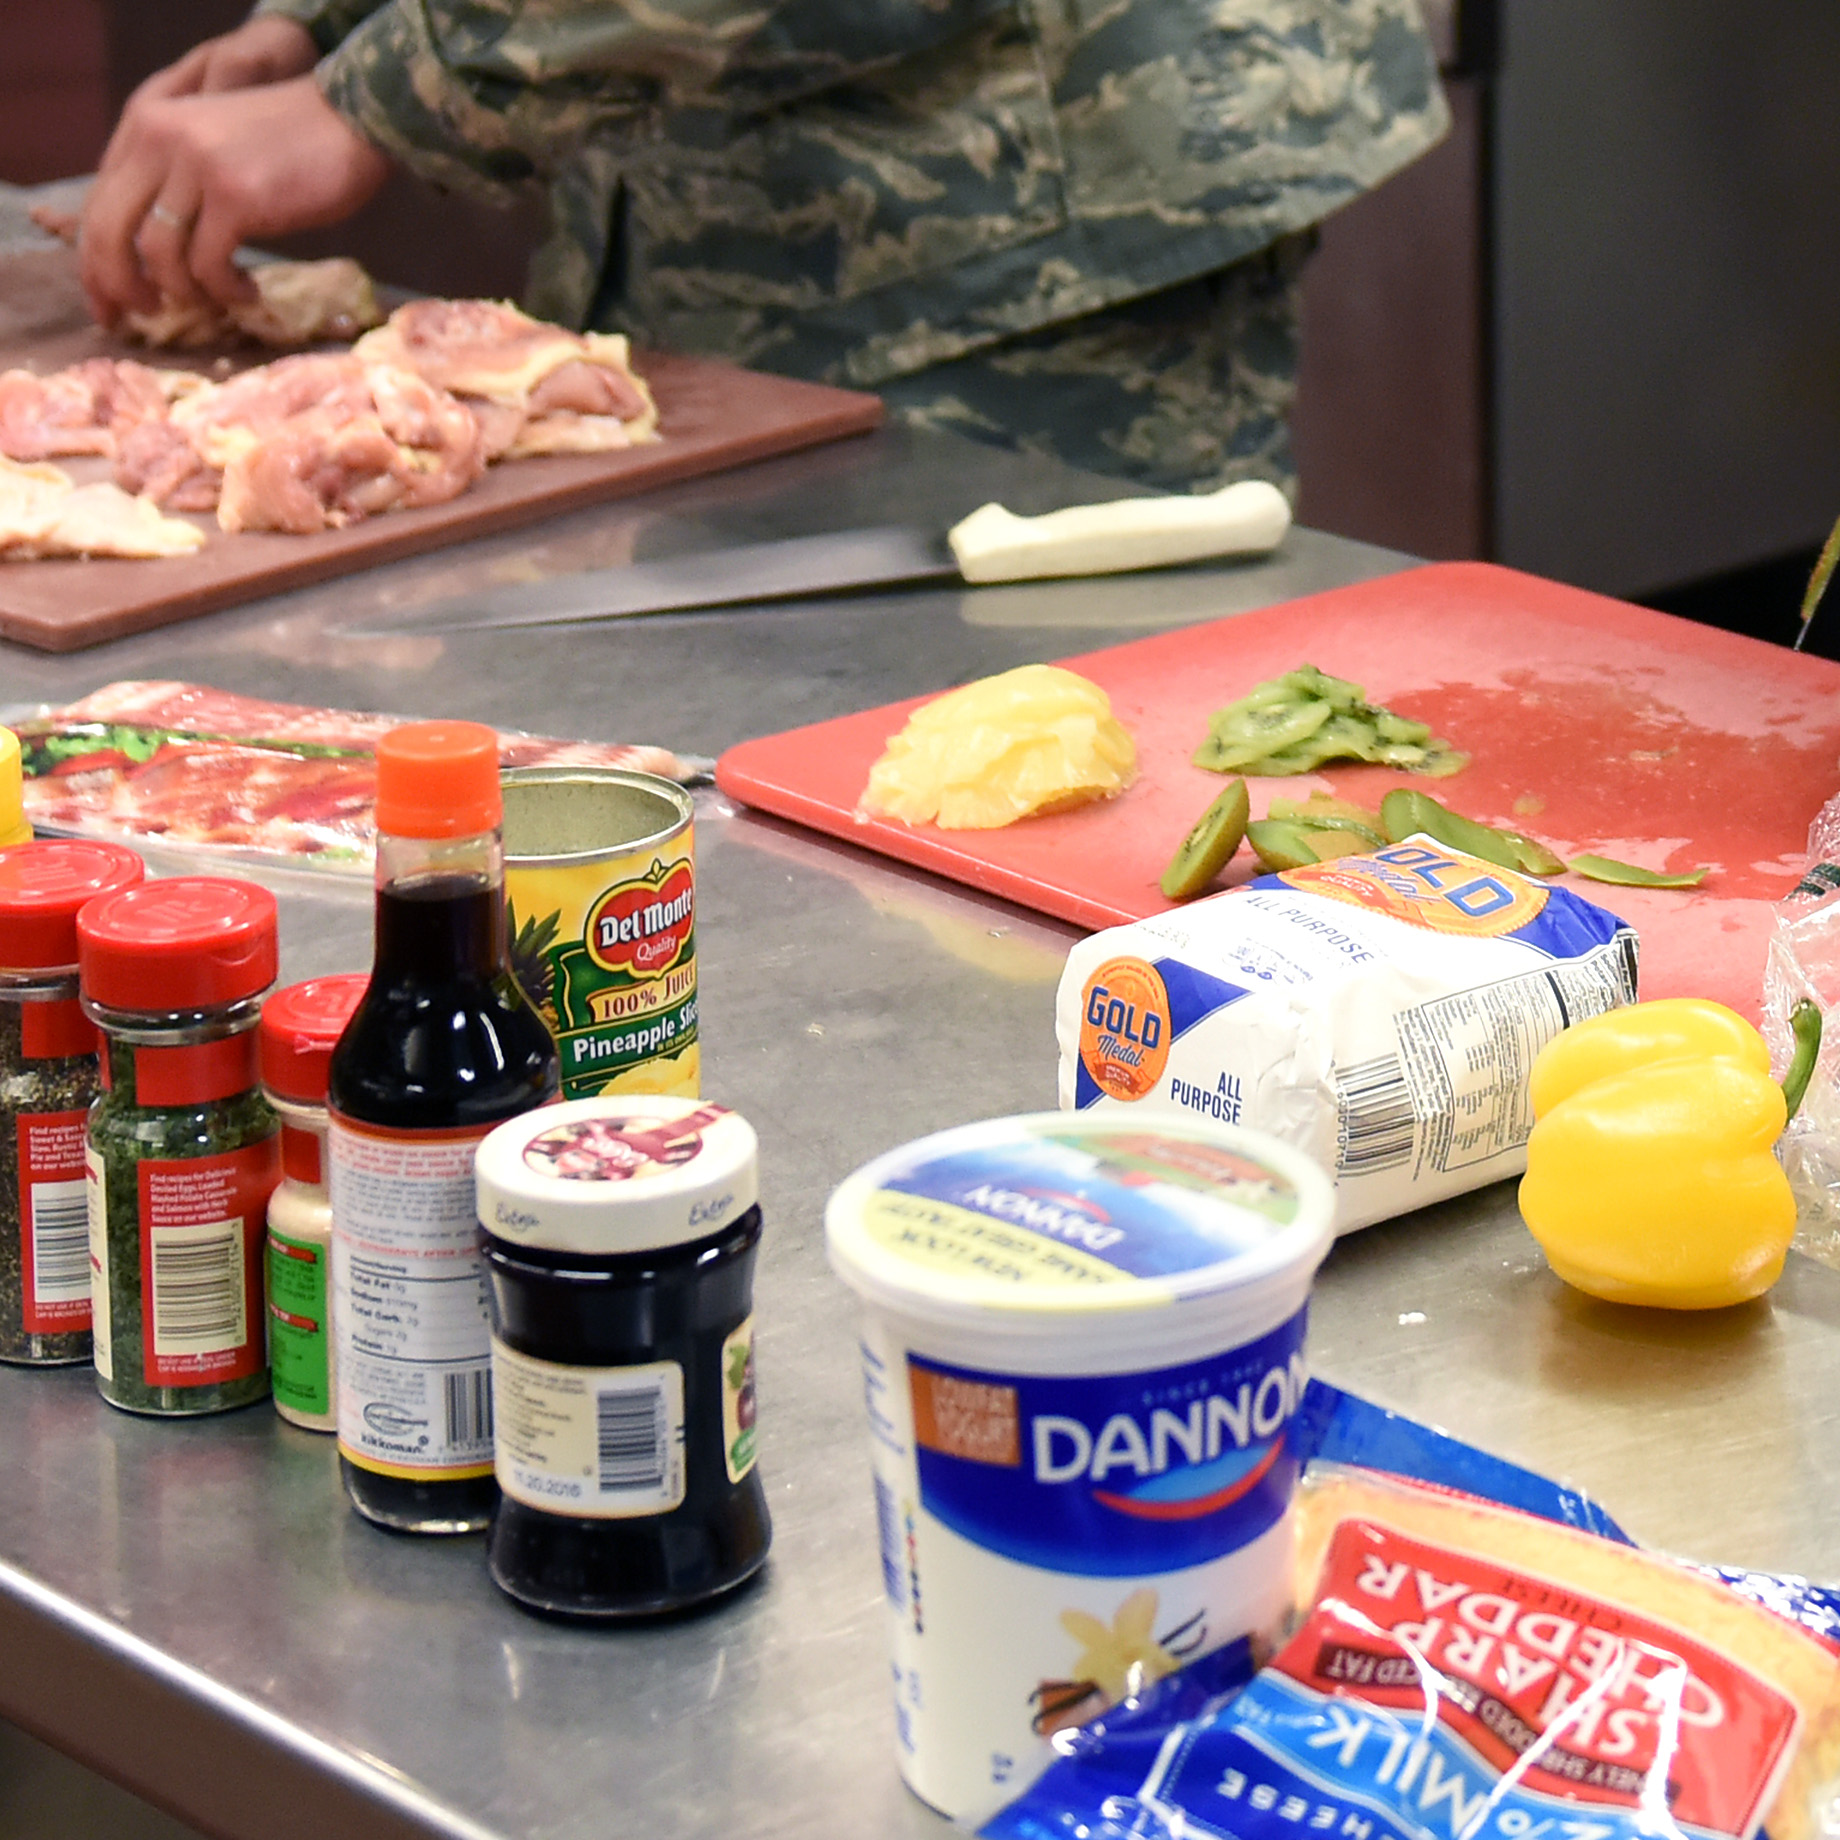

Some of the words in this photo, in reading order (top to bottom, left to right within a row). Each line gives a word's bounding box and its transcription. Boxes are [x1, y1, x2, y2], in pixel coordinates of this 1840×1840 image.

[1374, 847, 1516, 918] OLD
[600, 910, 641, 947] Del
[644, 887, 692, 938] Monte
[1245, 895, 1280, 912] ALL
[1281, 907, 1376, 963] PURPOSE
[636, 936, 677, 961] Quality
[603, 987, 657, 1018] 100%
[663, 960, 695, 1000] JUICE
[1086, 985, 1161, 1049] GOLD
[573, 1017, 675, 1063] Pineapple
[1097, 1034, 1145, 1068] Medal
[1171, 1077, 1242, 1125] PURPOSE
[1218, 1071, 1243, 1102] ALL
[150, 1174, 165, 1183] Find
[166, 1175, 192, 1184] recipes
[962, 1182, 1127, 1251] DANNON
[1327, 1647, 1376, 1685] FAT
[1355, 1553, 1726, 1728] CHEDDAR
[1390, 1614, 1652, 1760] SHARP
[1304, 1703, 1489, 1834] MILK
[1218, 1765, 1392, 1840] HEESE
